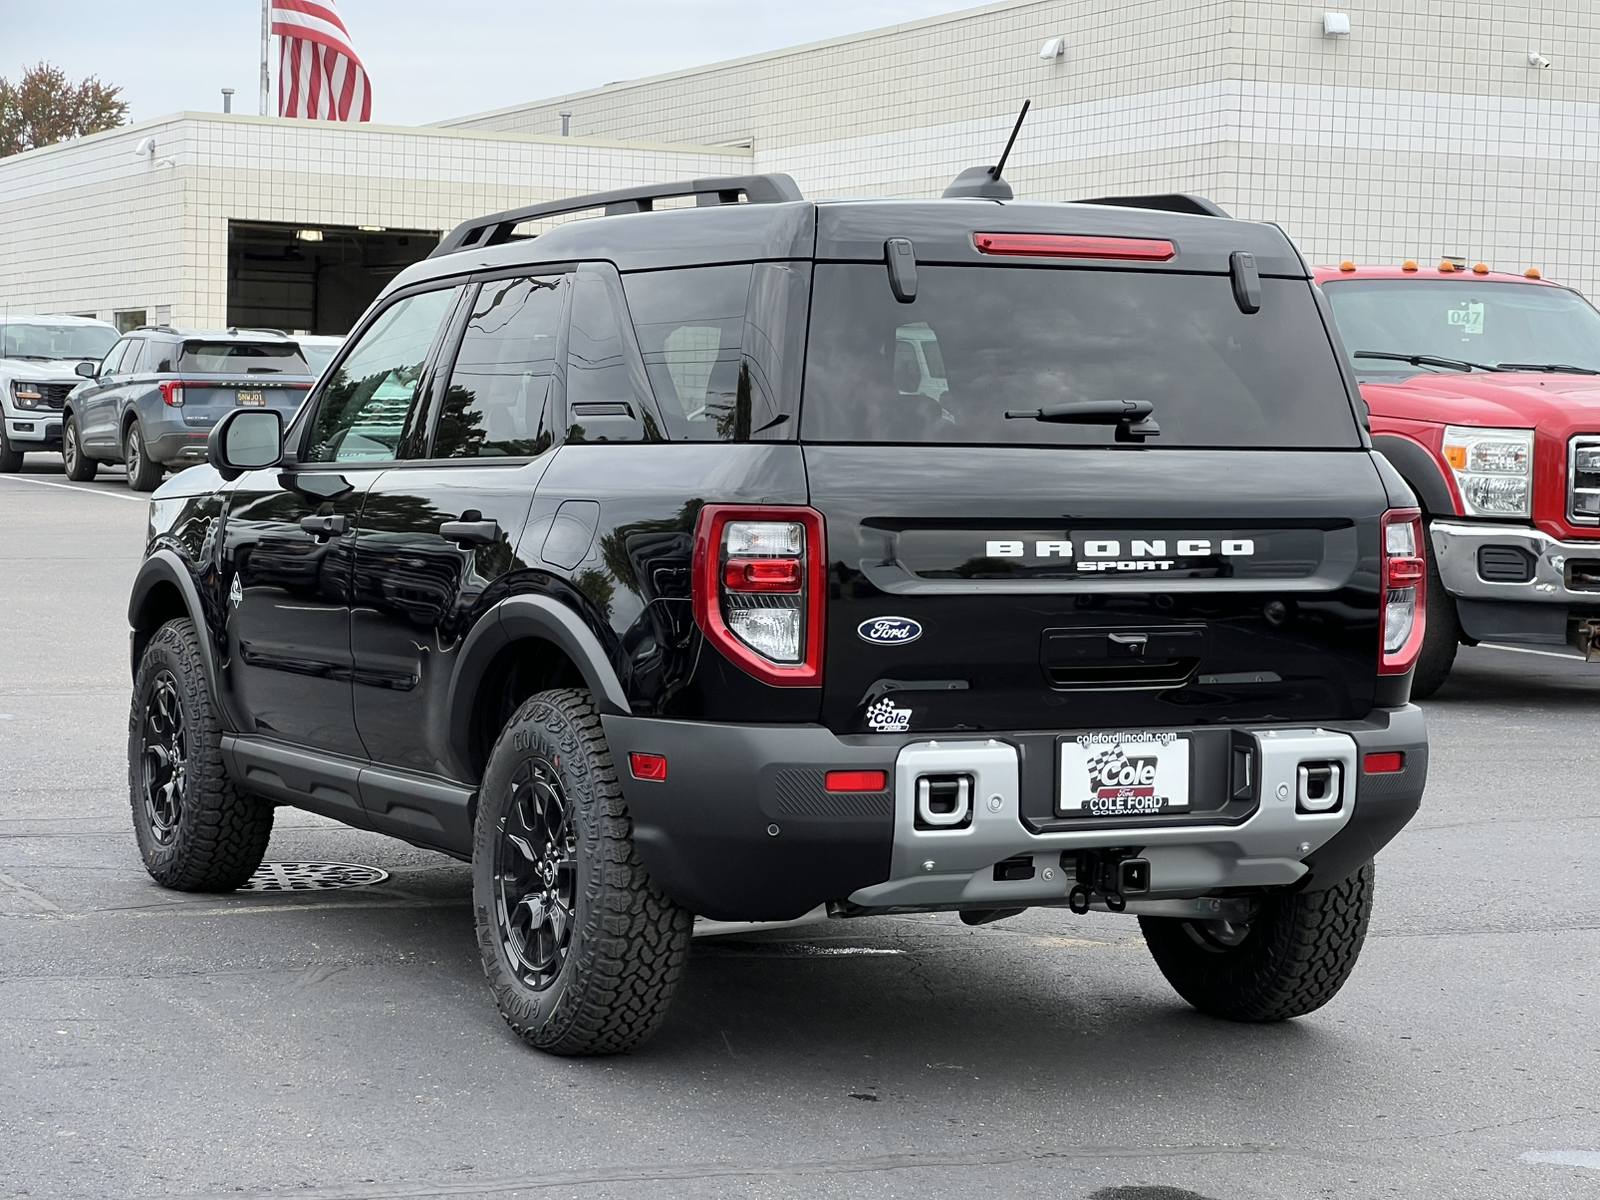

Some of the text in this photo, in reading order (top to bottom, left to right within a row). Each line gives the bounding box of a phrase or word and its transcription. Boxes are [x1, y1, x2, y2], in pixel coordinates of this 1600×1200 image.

[1451, 311, 1482, 325] 047
[985, 539, 1255, 557] BRONCO
[1076, 560, 1175, 571] SPORT
[873, 712, 907, 724] Cole
[1076, 731, 1178, 744] colefordlincoln.com
[1100, 760, 1156, 786] Cole
[1117, 788, 1134, 797] Ford
[1089, 795, 1163, 810] COLE FORD
[1092, 808, 1159, 816] COLDWATER
